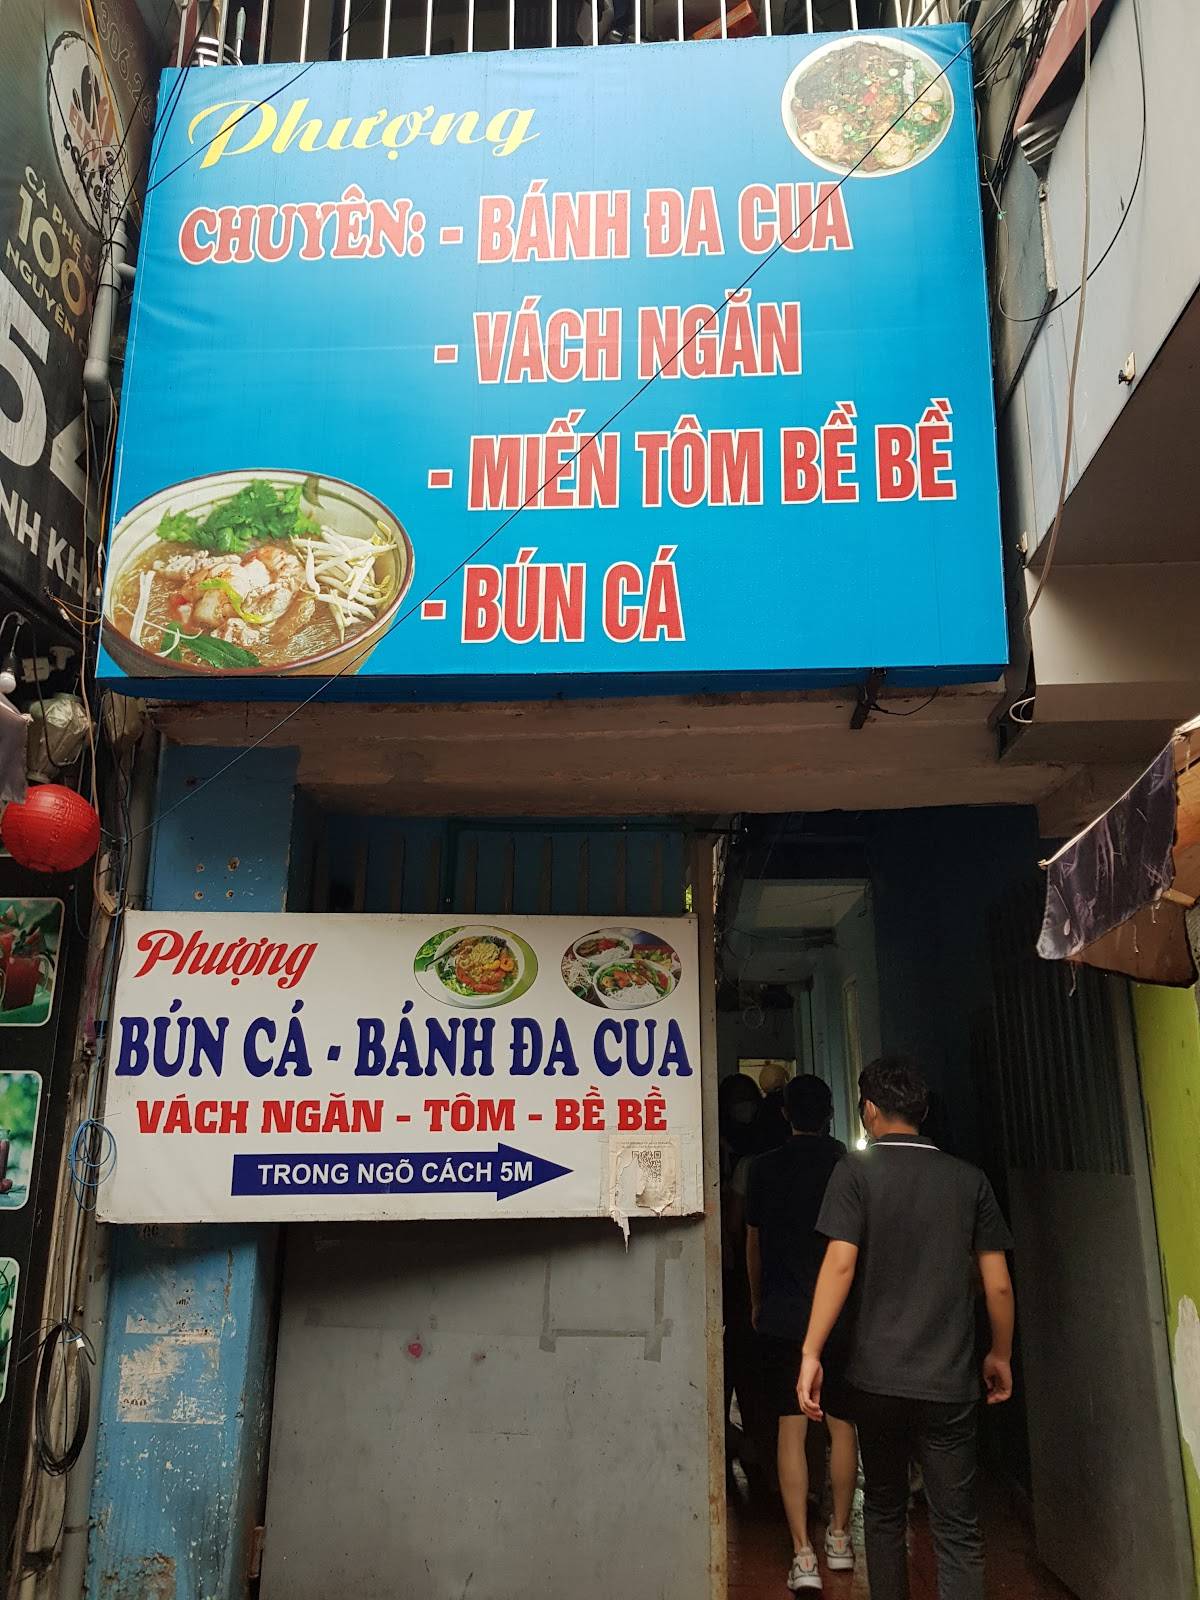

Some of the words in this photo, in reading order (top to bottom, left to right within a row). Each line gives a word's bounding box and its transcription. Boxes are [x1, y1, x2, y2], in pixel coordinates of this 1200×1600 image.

[188, 98, 541, 169] Phượng
[51, 203, 82, 258] PHÊ
[178, 184, 425, 264] CHUYÊN:
[477, 178, 631, 264] BÁNH
[644, 186, 725, 259] ĐA
[738, 180, 853, 252] CUA
[5, 238, 76, 344] NGUYÊN
[473, 295, 622, 385] VÁCH
[637, 288, 803, 380] NGĂN
[467, 408, 620, 512] MIẾN
[635, 413, 763, 508] TÔM
[779, 400, 860, 505] BỀ
[874, 397, 957, 502] BỀ
[460, 547, 587, 644] BÚN
[602, 544, 686, 643] CÁ
[134, 929, 318, 988] Phượng
[114, 998, 230, 1078] BÚN
[243, 1000, 312, 1078] CÁ
[354, 1000, 496, 1078] BÁNH
[509, 1017, 579, 1077] ĐA
[593, 1017, 693, 1077] CUA
[136, 1093, 250, 1134] VÁCH
[262, 1092, 385, 1134] NGĂN
[423, 1092, 515, 1132] TÔM
[555, 1085, 605, 1131] BỀ
[617, 1085, 667, 1131] BỀ
[257, 1163, 349, 1186] TRONG
[357, 1161, 414, 1186] NGÕ
[421, 1159, 494, 1184] CÁCH
[499, 1161, 534, 1183] 5M
